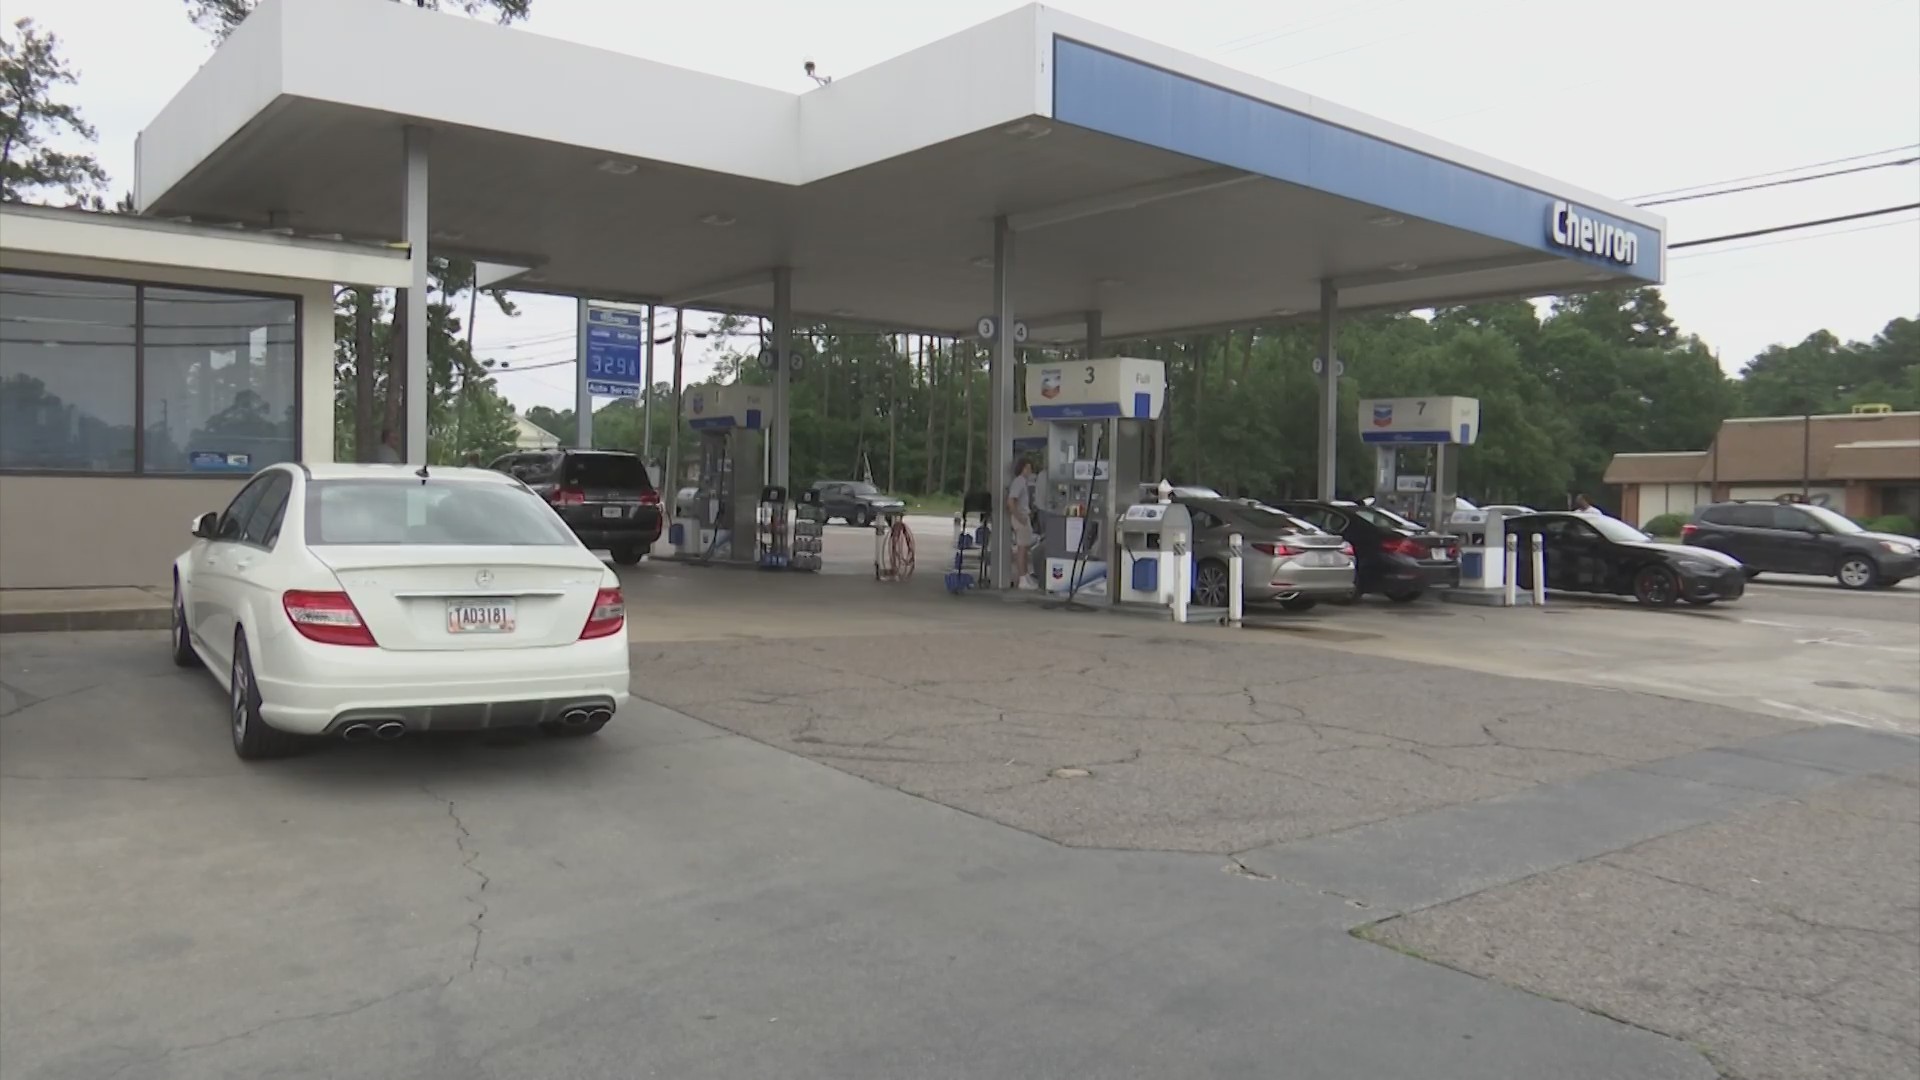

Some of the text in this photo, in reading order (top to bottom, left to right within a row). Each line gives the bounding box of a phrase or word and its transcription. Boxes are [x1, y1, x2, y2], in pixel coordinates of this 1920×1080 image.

[1550, 199, 1638, 264] Chevron
[1084, 366, 1095, 384] 3
[1416, 401, 1426, 416] 7
